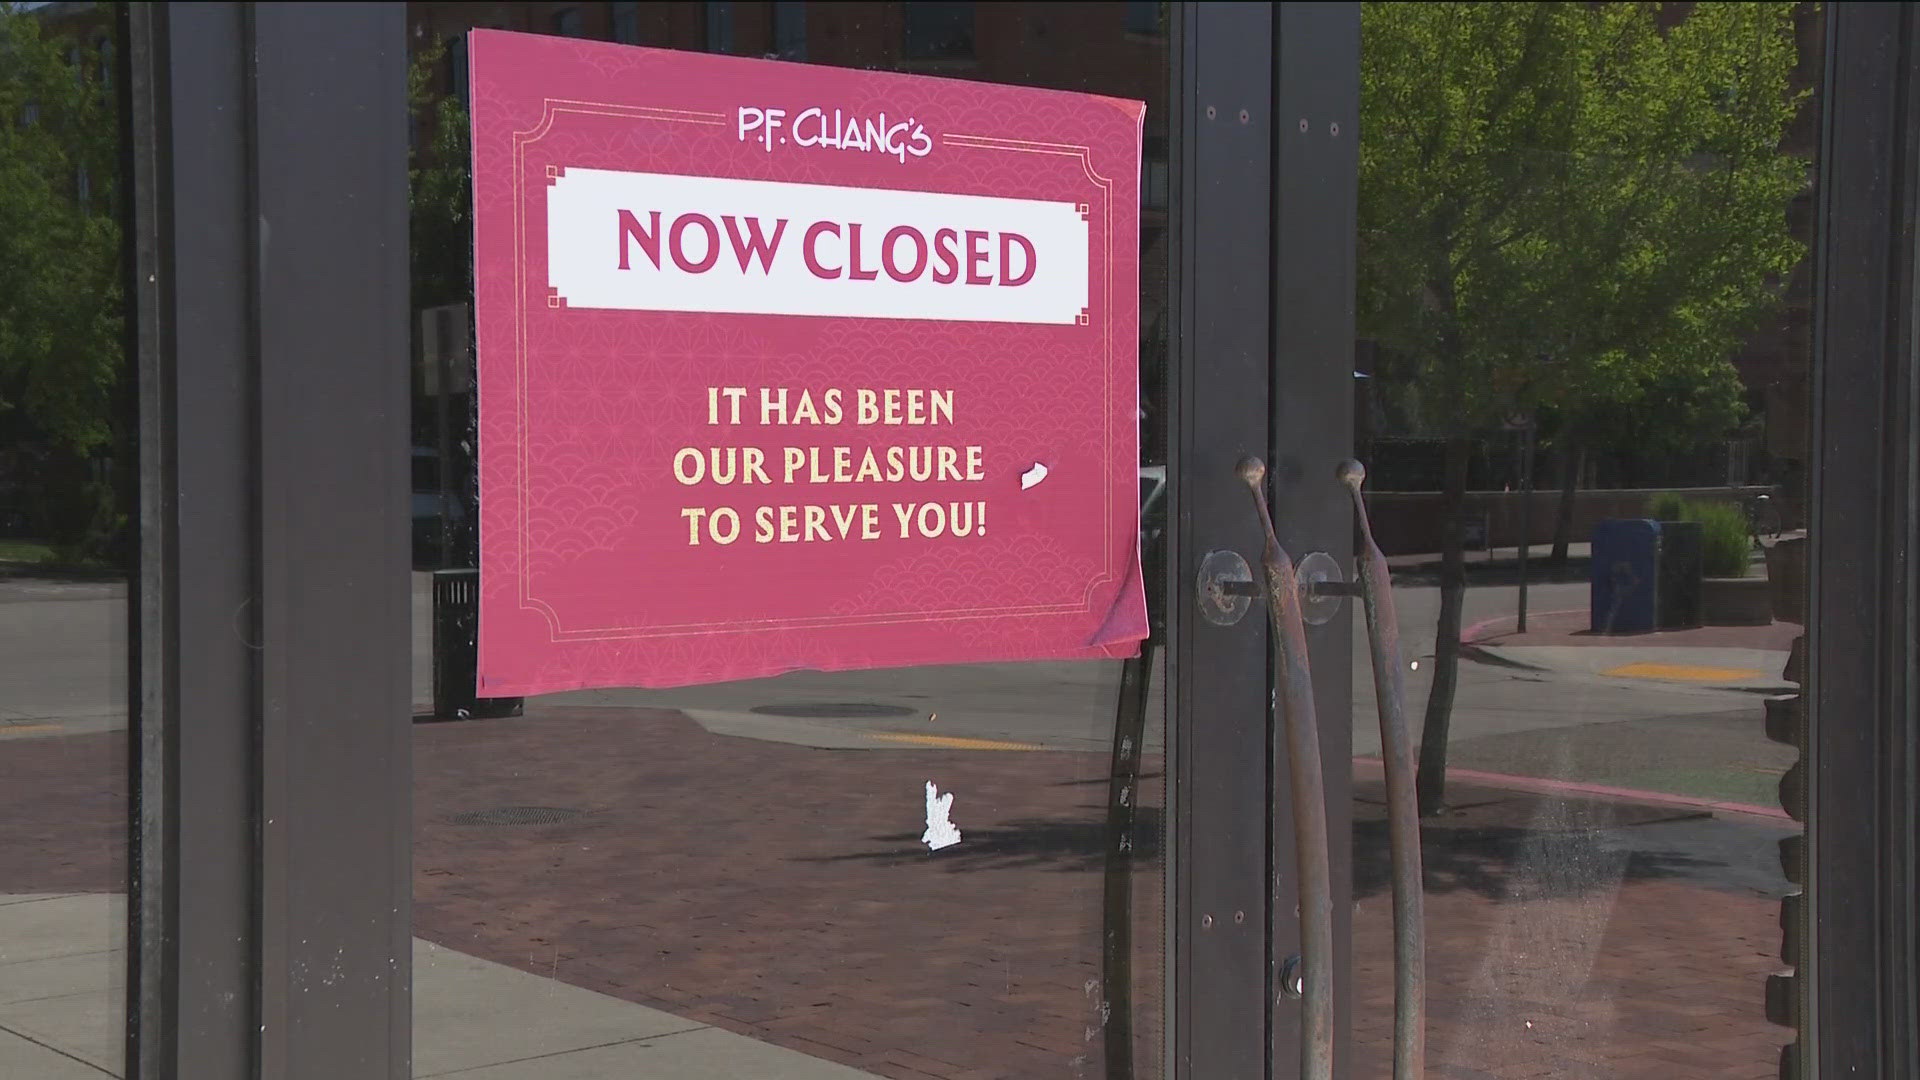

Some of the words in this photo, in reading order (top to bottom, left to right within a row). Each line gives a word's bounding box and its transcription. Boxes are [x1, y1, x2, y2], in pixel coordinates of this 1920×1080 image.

[738, 106, 787, 153] P.F.
[792, 106, 934, 164] CHANG'S
[617, 208, 789, 276] NOW
[802, 220, 1037, 287] CLOSED
[707, 387, 748, 425] IT
[759, 387, 843, 425] HAS
[856, 388, 954, 425] BEEN
[673, 447, 772, 486] OUR
[783, 446, 985, 484] PLEASURE
[680, 507, 741, 546] TO
[755, 504, 882, 544] SERVE
[891, 501, 987, 539] YOU!
